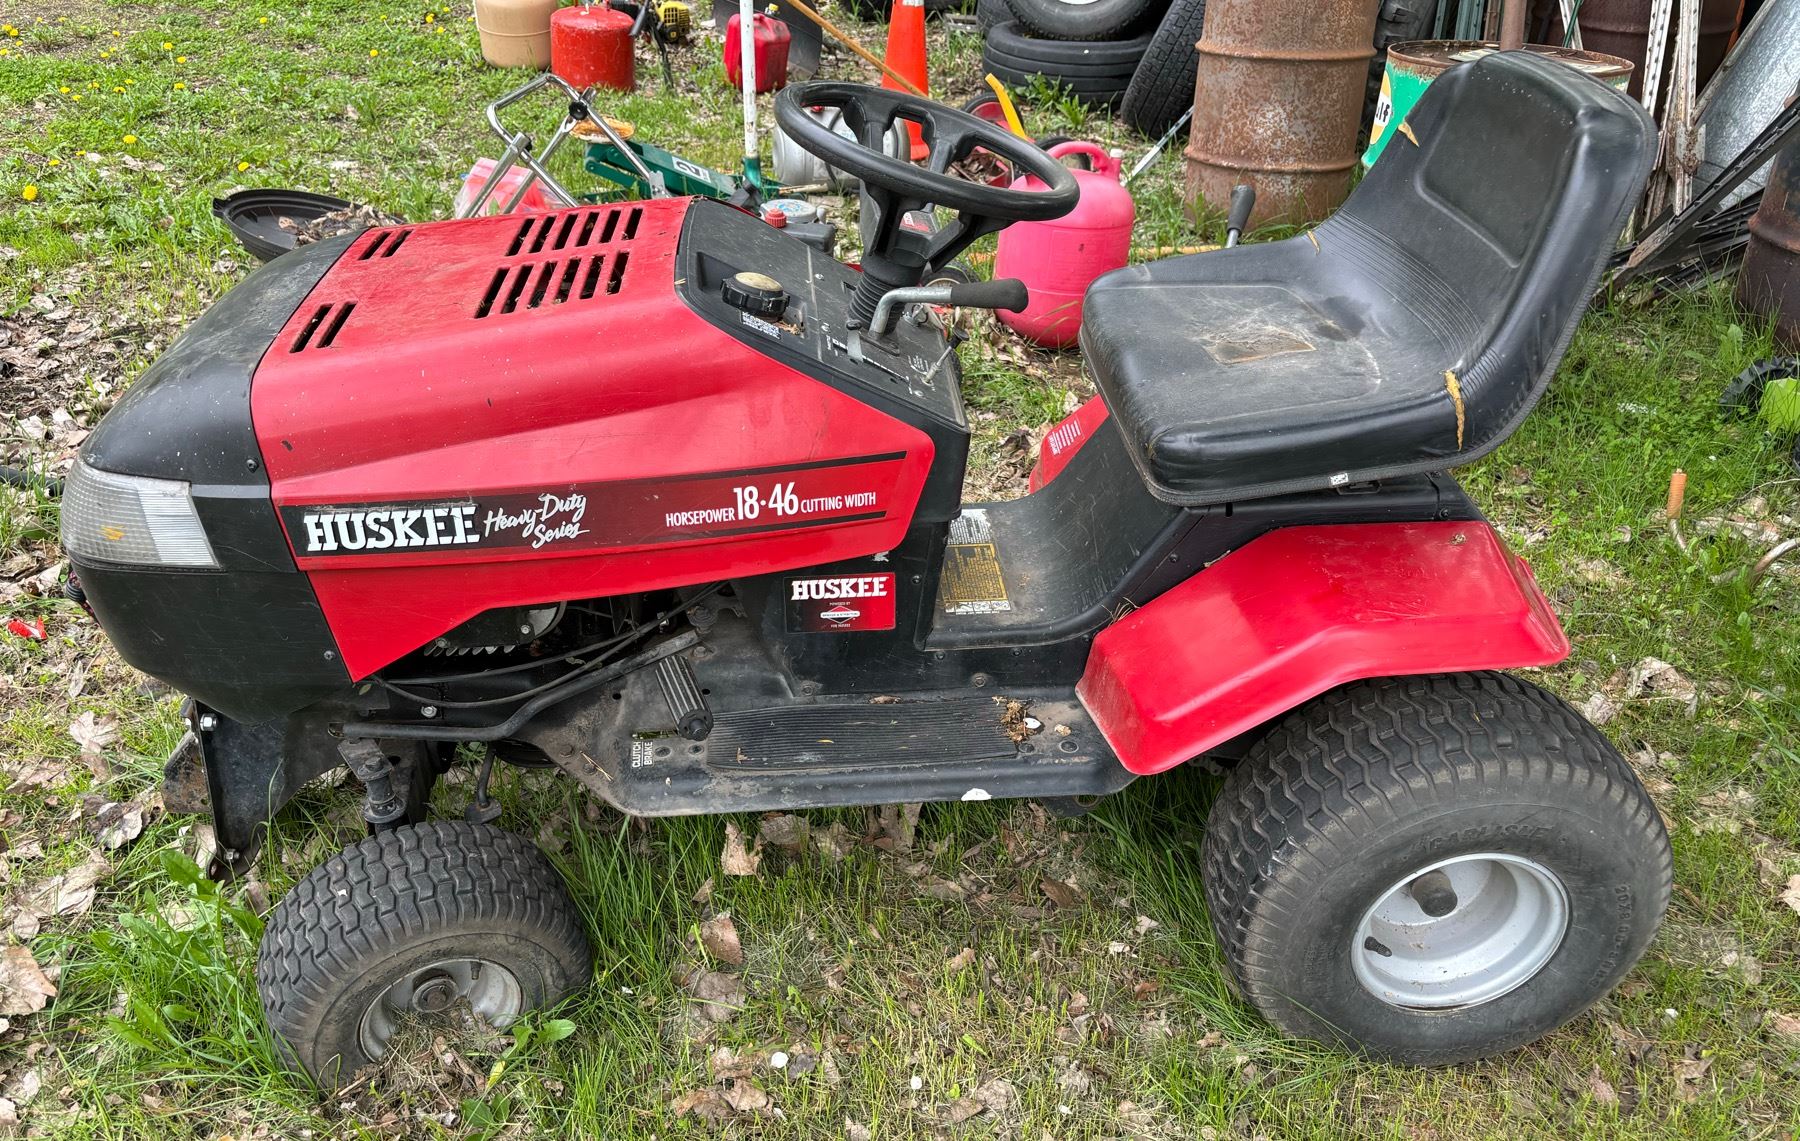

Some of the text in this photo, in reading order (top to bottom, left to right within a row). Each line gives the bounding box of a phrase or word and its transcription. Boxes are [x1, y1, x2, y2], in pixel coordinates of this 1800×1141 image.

[676, 160, 701, 177] 2
[665, 507, 736, 527] HORSEPOWER
[800, 495, 843, 514] CUTTING
[844, 491, 876, 508] WIDTH
[303, 503, 480, 551] HUSKEE
[531, 521, 590, 549] Series
[791, 576, 889, 600] HUSKEE
[632, 741, 641, 768] CLUTCH
[644, 741, 653, 765] BRAKE
